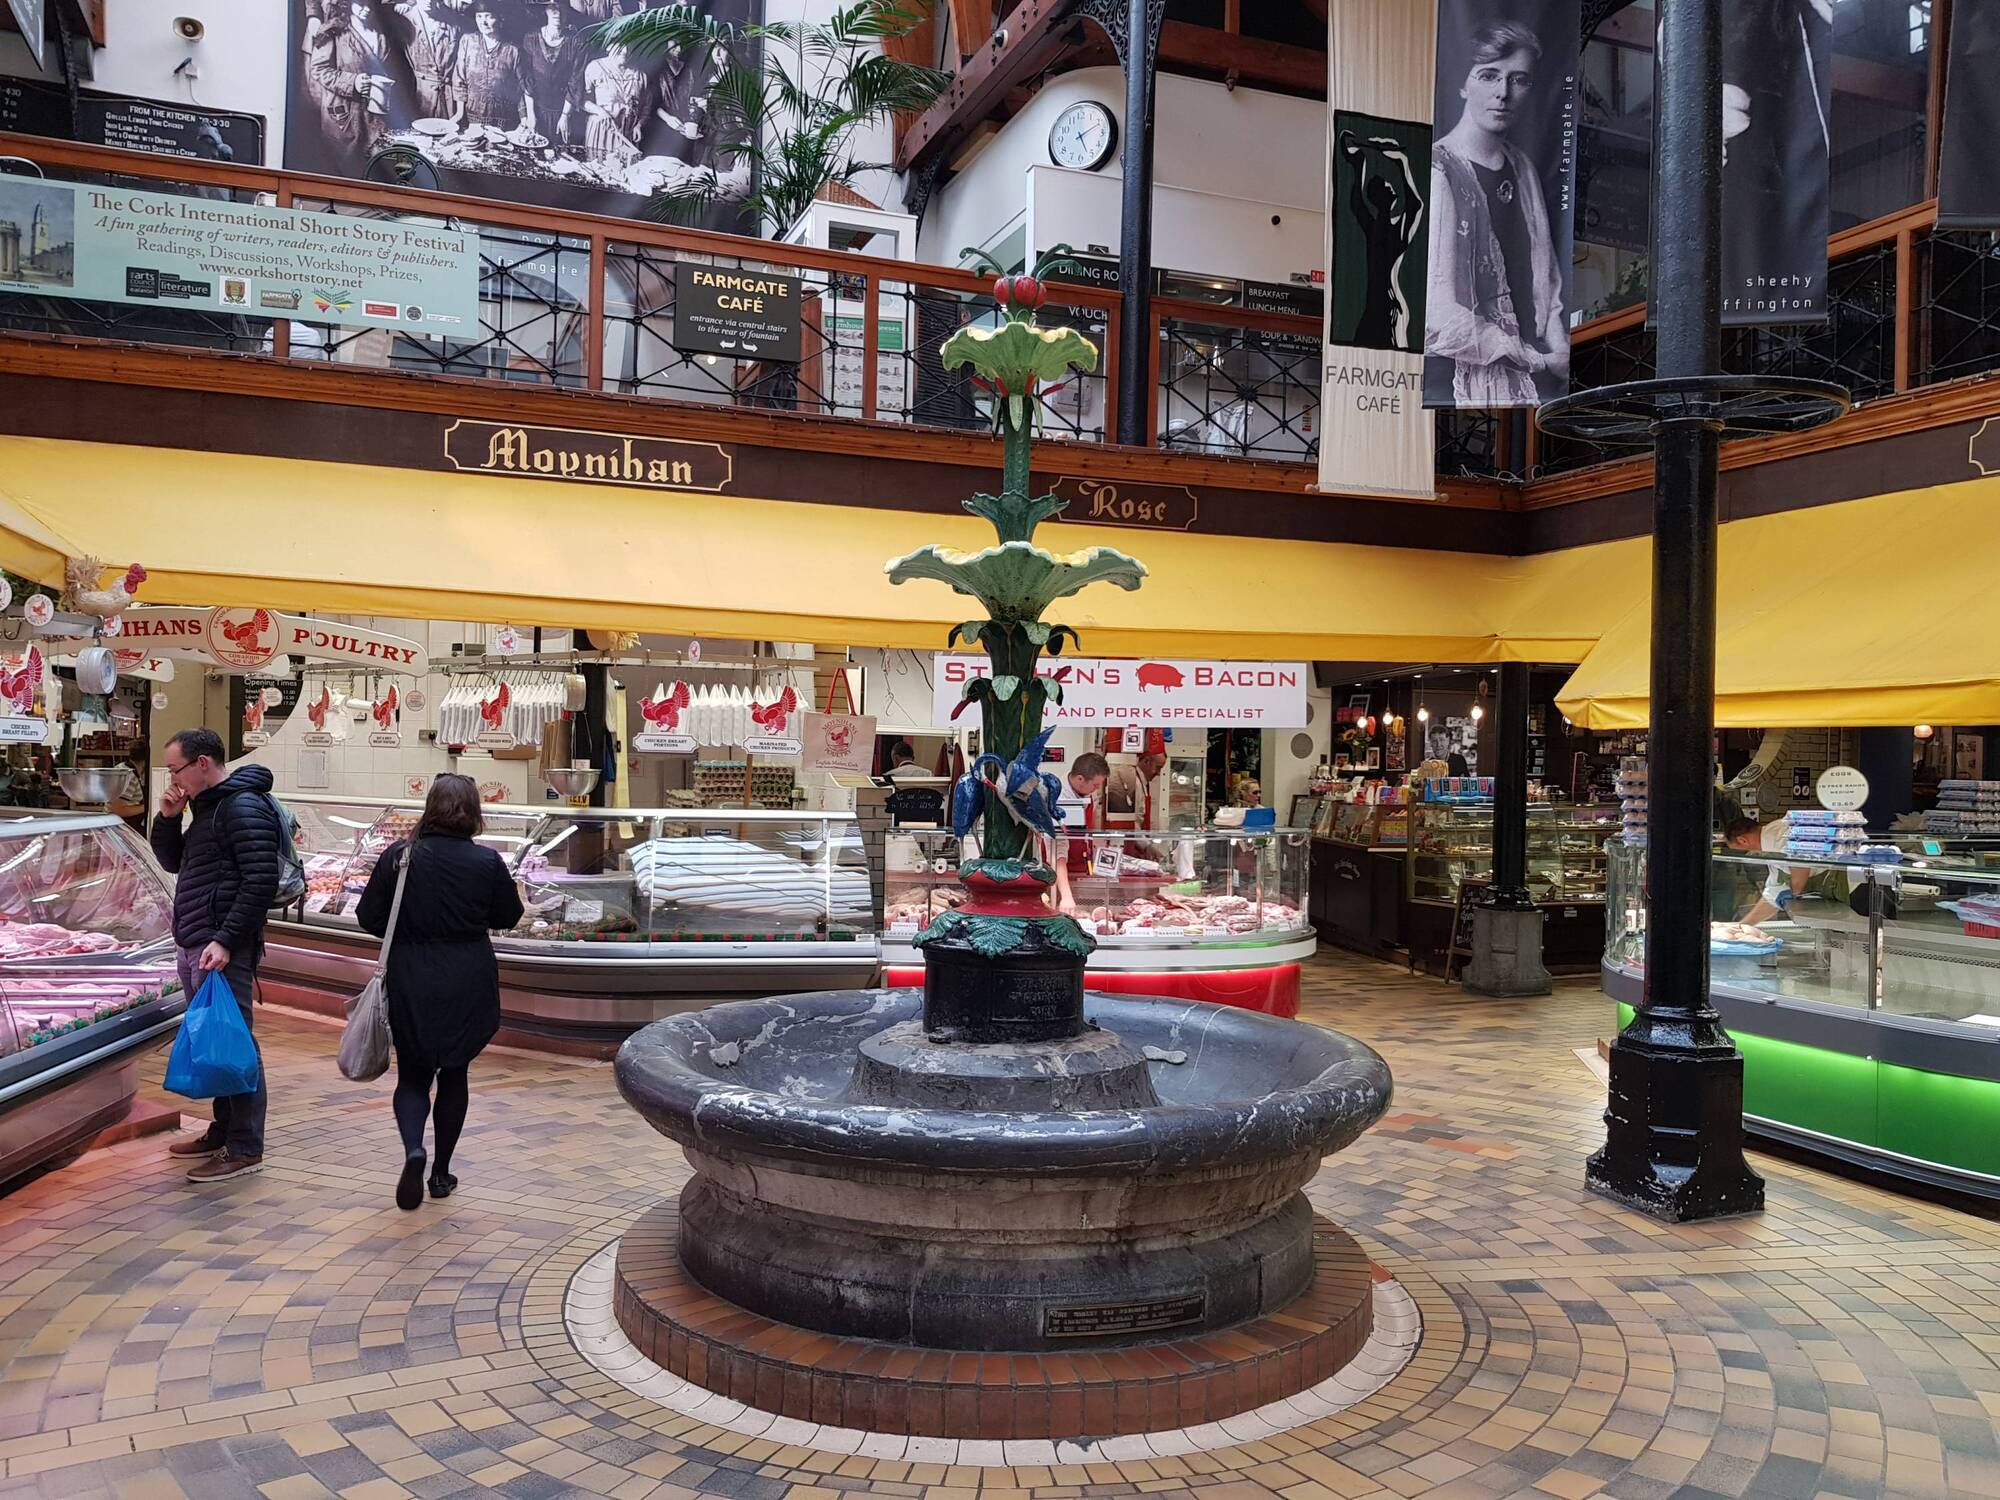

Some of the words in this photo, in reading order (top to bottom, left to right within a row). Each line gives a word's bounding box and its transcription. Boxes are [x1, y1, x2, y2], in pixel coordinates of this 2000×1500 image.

[129, 105, 150, 115] FROM
[152, 109, 166, 118] THE
[166, 112, 196, 122] KITCHEN
[1560, 75, 1574, 211] www.farmgate.ie
[88, 191, 123, 211] The
[128, 197, 175, 217] Cork
[180, 203, 295, 231] International
[300, 217, 349, 237] Short
[352, 224, 398, 248] Story
[403, 231, 465, 254] Festival
[94, 216, 107, 227] A
[107, 217, 134, 232] fun
[136, 223, 204, 242] gathering
[206, 229, 223, 243] of
[222, 233, 274, 248] writers,
[277, 238, 327, 253] readers,
[331, 244, 373, 258] editors
[376, 247, 391, 259] &
[391, 249, 458, 269] publishers.
[571, 238, 615, 253] 206
[137, 237, 206, 259] Readings,
[209, 243, 293, 268] Discussions,
[296, 254, 376, 278] Workshops,
[379, 265, 423, 283] Prizes,
[497, 255, 578, 277] farmgate
[200, 263, 363, 289] www.corkshortstory.net
[1059, 264, 1101, 279] DIING
[160, 281, 209, 294] literature
[693, 271, 788, 297] FARMGATE
[1746, 275, 1812, 288] sheehy
[1248, 288, 1290, 300] BREAKFAST
[717, 295, 764, 313] CAFÉ
[1068, 305, 1108, 320] VOUCH
[1248, 302, 1276, 313] LUNCH
[1277, 306, 1300, 315] MENU
[1723, 297, 1812, 312] ffington
[689, 314, 724, 325] entrance
[725, 318, 737, 327] via
[738, 320, 765, 331] central
[766, 323, 788, 333] stairs
[697, 324, 706, 332] to
[707, 325, 720, 334] the
[721, 328, 737, 336] rear
[739, 330, 748, 339] of
[747, 330, 780, 341] fountain
[1293, 334, 1322, 344] SANDW
[1356, 395, 1401, 414] CAFÉ
[480, 428, 693, 478] Moynihan
[1078, 481, 1168, 522] Rose
[116, 619, 203, 639] IHANS
[292, 628, 418, 665] POULTRY
[244, 679, 275, 689] Opening
[276, 679, 298, 687] Times
[1194, 663, 1296, 688] BACON
[1056, 706, 1096, 718] AND
[1104, 707, 1153, 718] PORK
[1161, 708, 1265, 719] SPECIALIST
